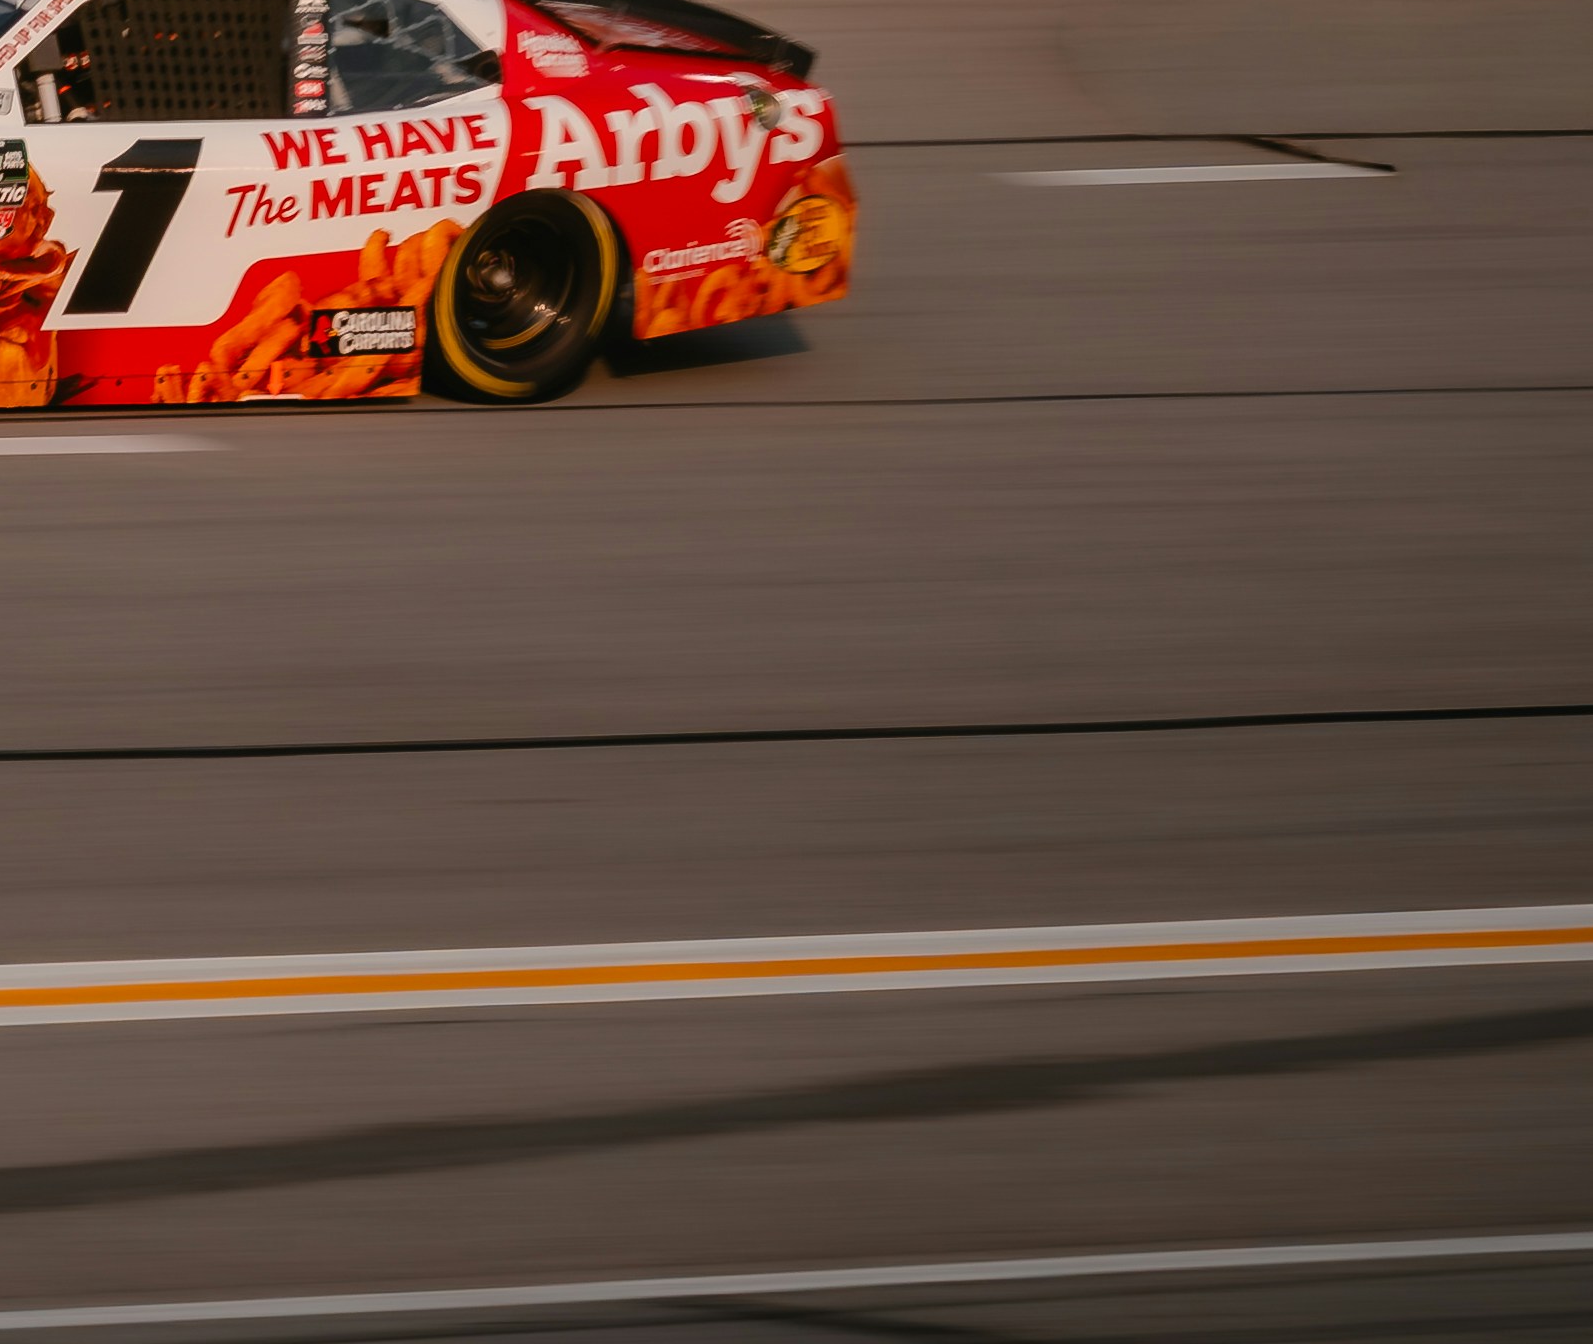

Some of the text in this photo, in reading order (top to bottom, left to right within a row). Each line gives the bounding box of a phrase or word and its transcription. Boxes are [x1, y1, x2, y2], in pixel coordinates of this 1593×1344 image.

[261, 113, 499, 171] WE HAVE
[62, 137, 203, 315] 1
[226, 163, 484, 238] The MEATS
